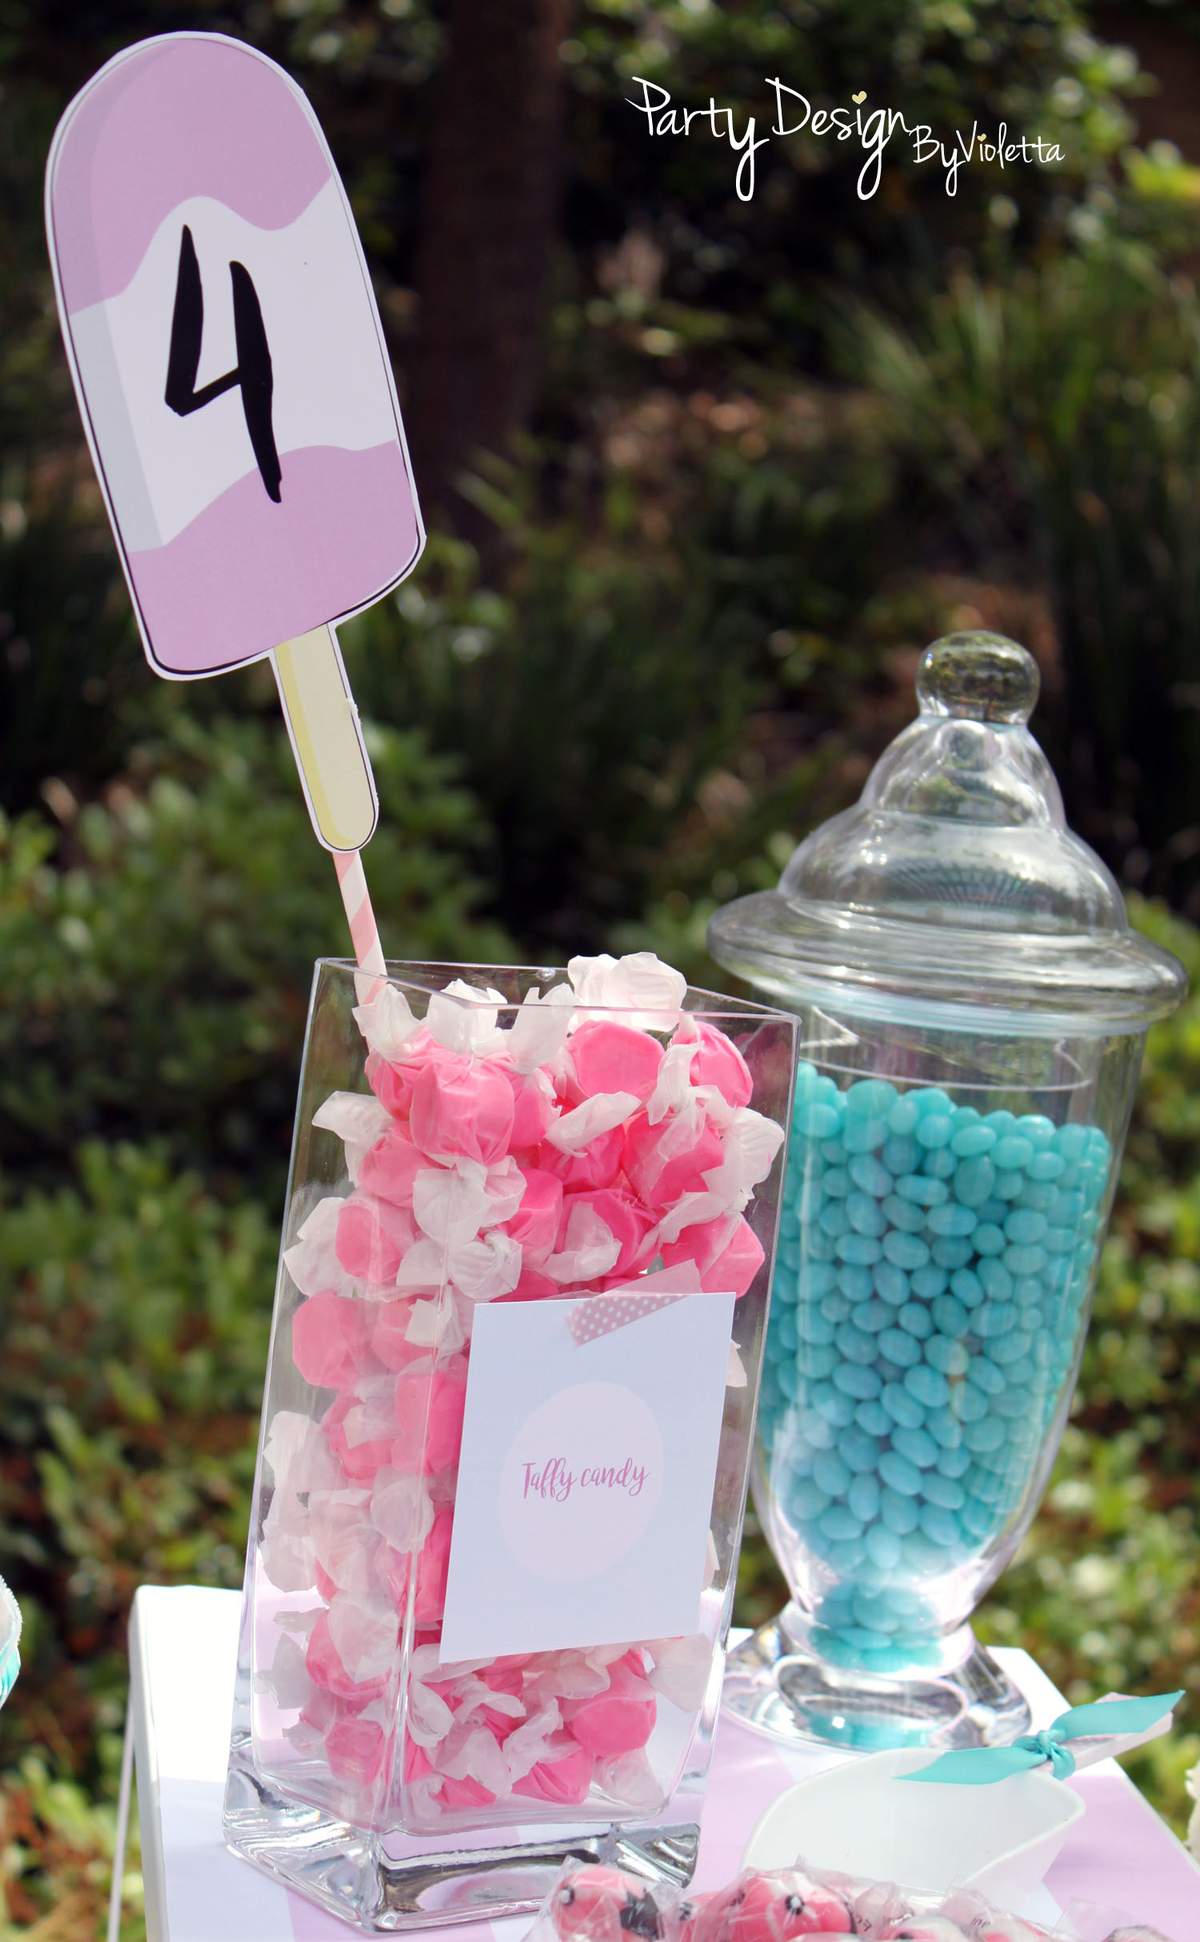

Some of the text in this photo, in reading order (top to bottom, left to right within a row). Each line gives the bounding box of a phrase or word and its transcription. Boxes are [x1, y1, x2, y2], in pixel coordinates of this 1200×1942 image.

[164, 224, 282, 504] 4
[521, 1457, 650, 1502] Taffy candy
